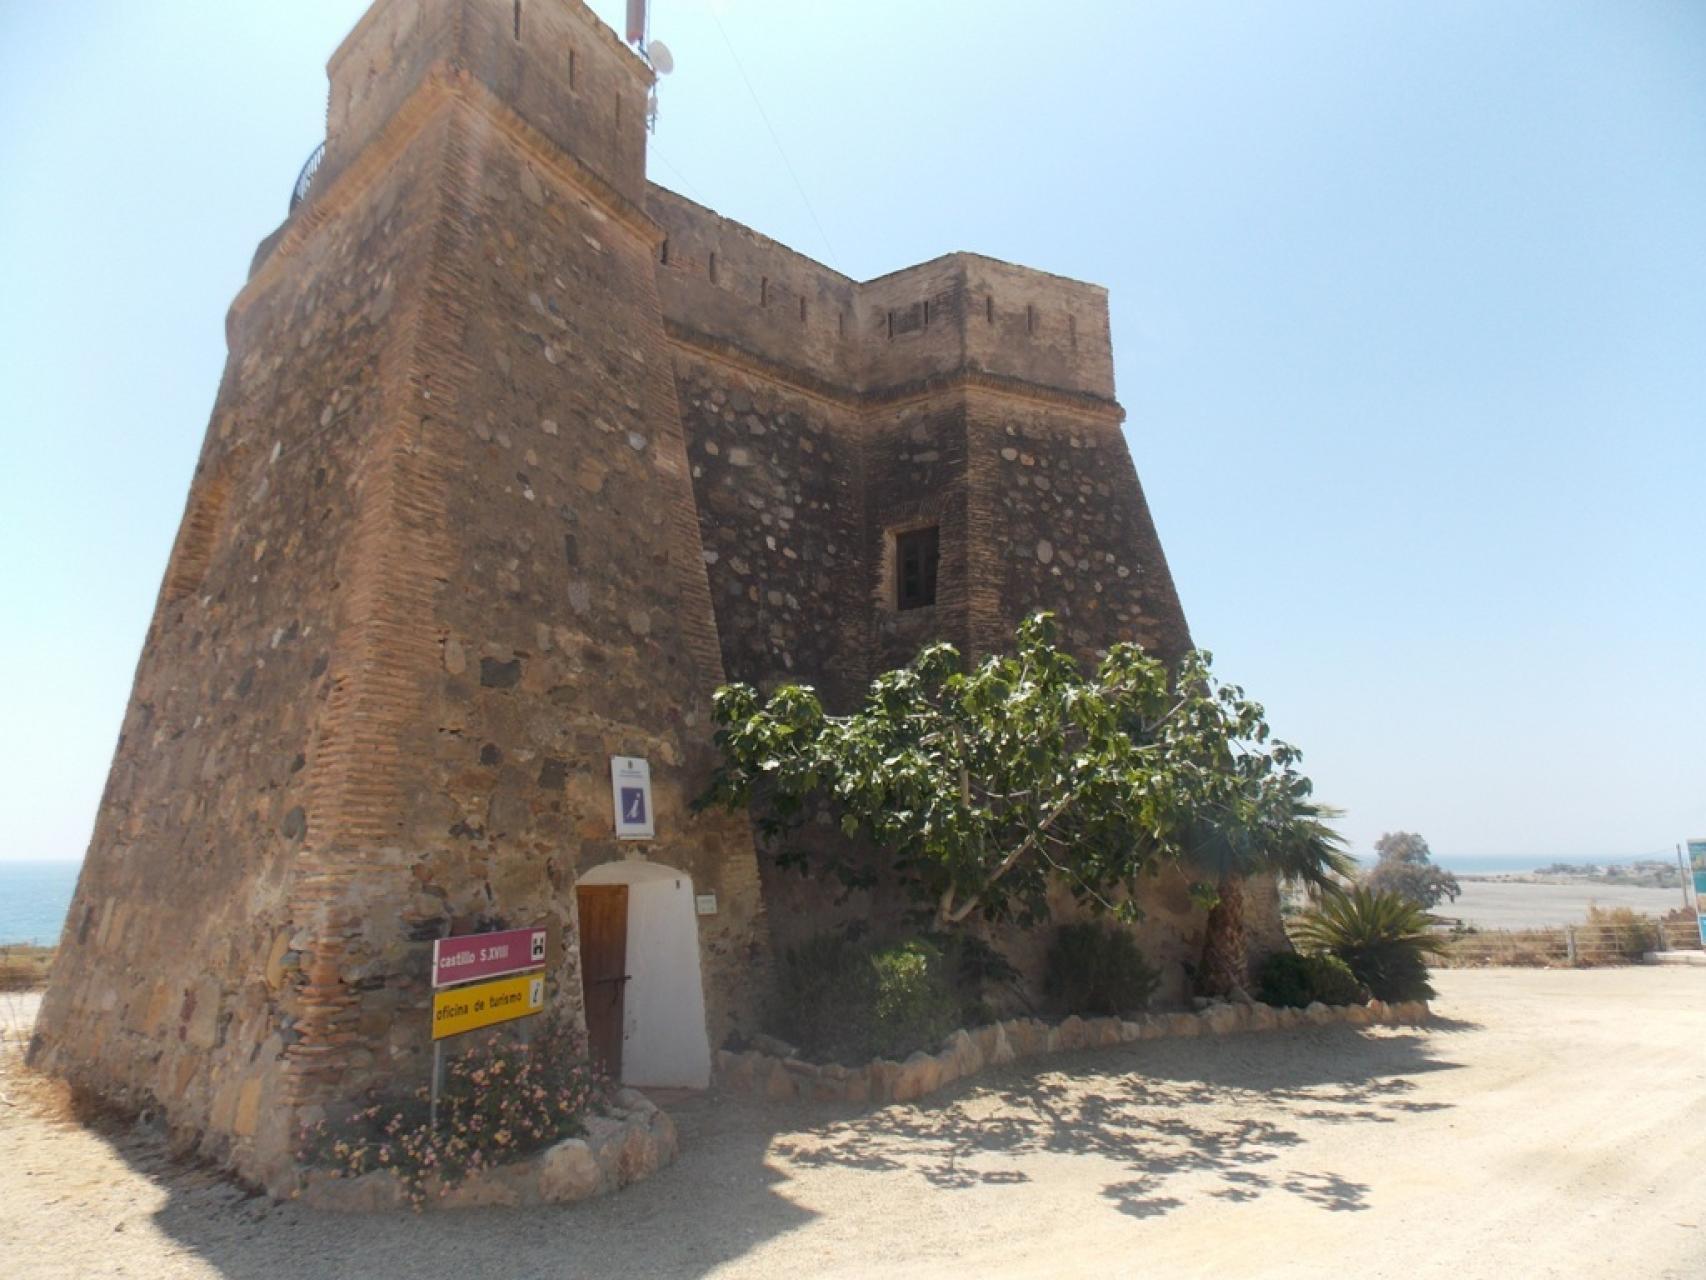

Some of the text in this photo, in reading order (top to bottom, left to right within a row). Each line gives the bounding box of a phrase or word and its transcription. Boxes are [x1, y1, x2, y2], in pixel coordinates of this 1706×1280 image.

[440, 951, 475, 968] castillo
[436, 1004, 468, 1021] oficina
[474, 1000, 484, 1012] de
[489, 992, 522, 1008] turismo
